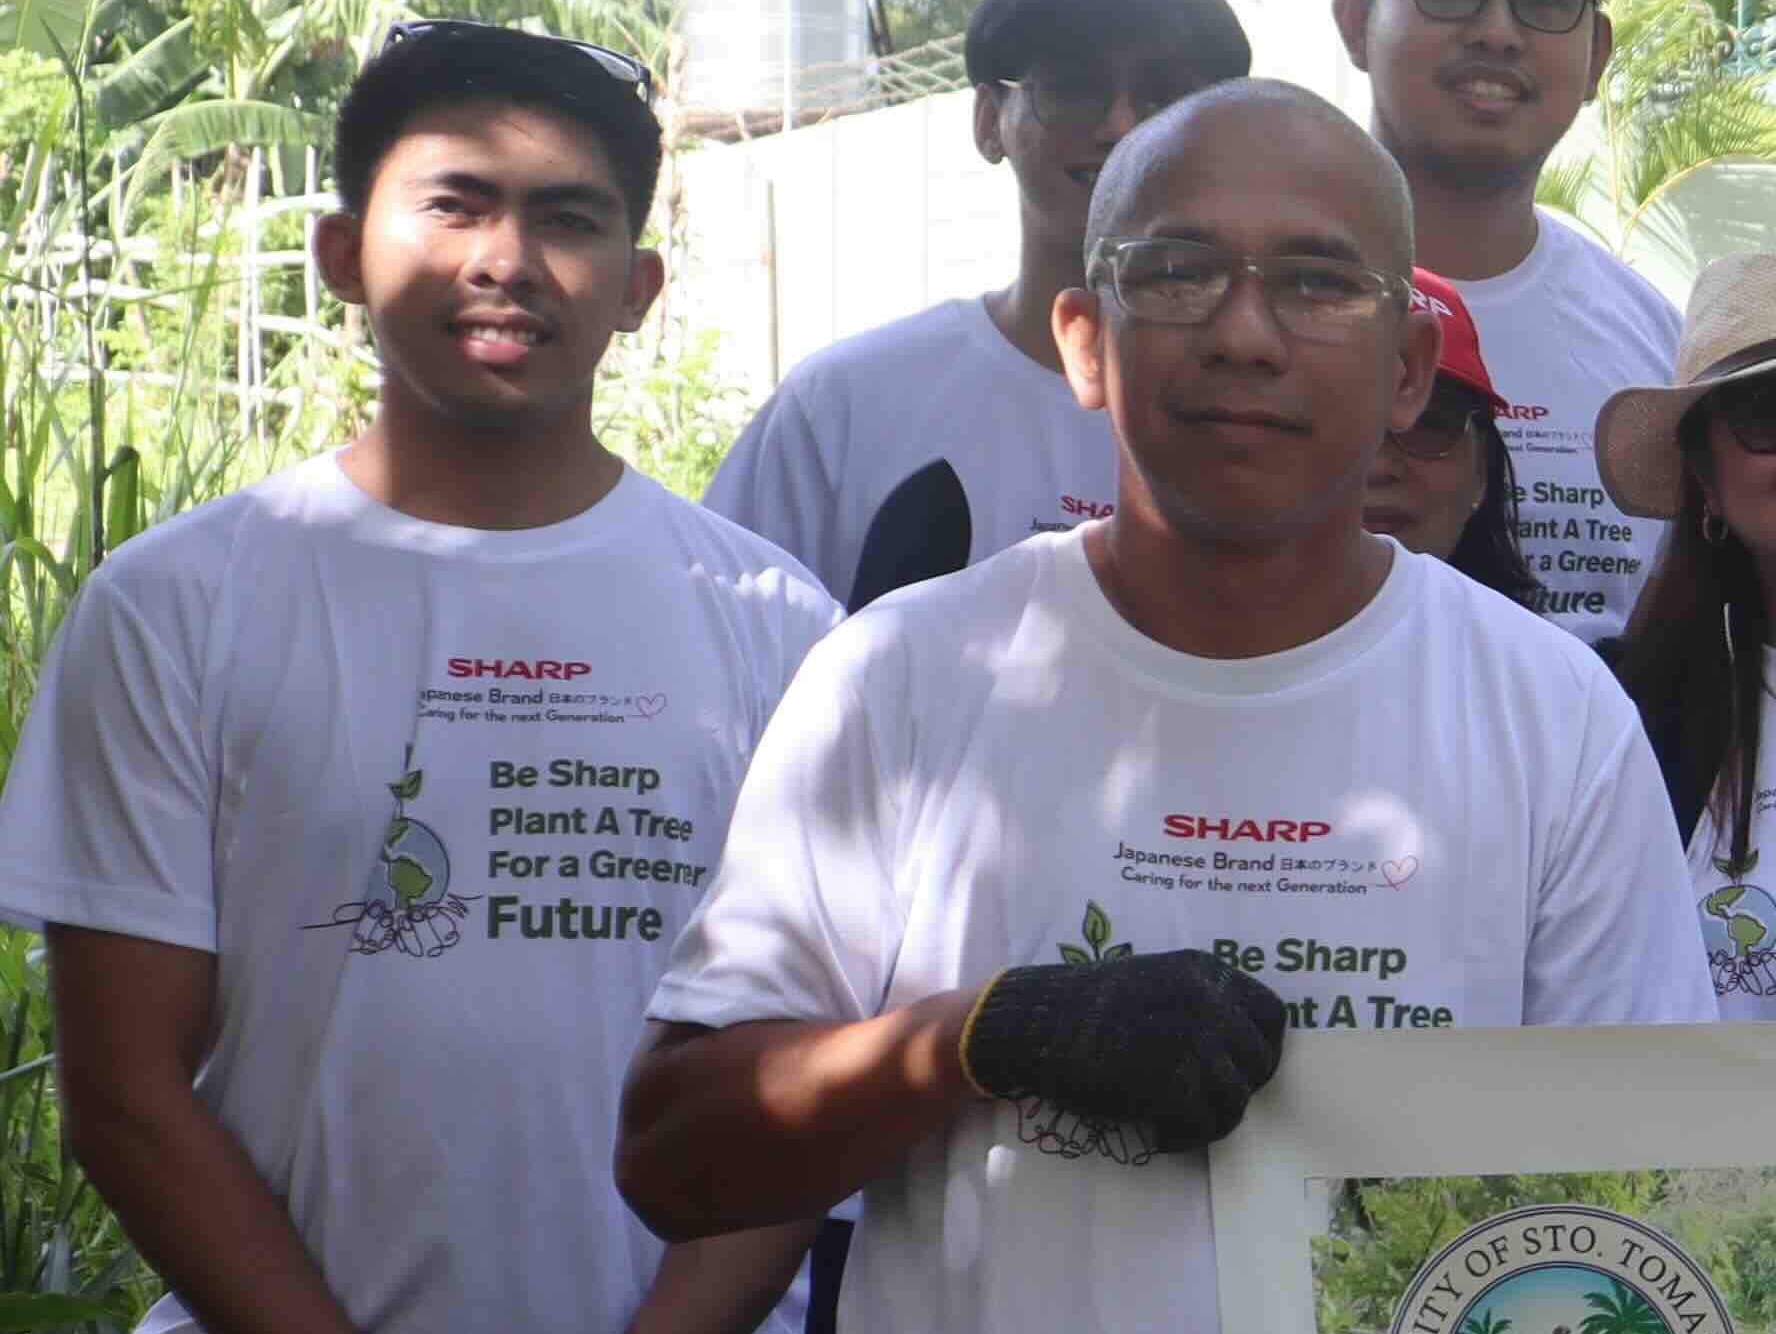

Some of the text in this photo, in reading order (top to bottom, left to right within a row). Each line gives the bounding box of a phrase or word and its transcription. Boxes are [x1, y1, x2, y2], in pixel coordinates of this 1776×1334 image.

[1533, 481, 1604, 509] Sharp
[1519, 518, 1632, 542] ant A Tree
[1535, 586, 1606, 615] ture
[447, 658, 592, 680] SHARP
[420, 687, 483, 705] apanese
[488, 687, 543, 705] Brand
[485, 708, 506, 722] the
[545, 709, 625, 723] Generation
[490, 759, 660, 795] Be Sharp
[489, 807, 693, 842] Plant A Tree
[1163, 814, 1332, 843] SHARP
[488, 850, 551, 879] For
[558, 855, 580, 879] a
[1113, 841, 1206, 869] Japanese
[1213, 851, 1276, 872] Brand
[1121, 867, 1367, 895] Caring for the next Generation
[486, 896, 664, 941] Future
[1274, 937, 1407, 980] Sharp
[1326, 996, 1357, 1028] A
[1366, 995, 1453, 1029] Tree
[1463, 1236, 1511, 1278] OF
[1523, 1225, 1604, 1258] STO.
